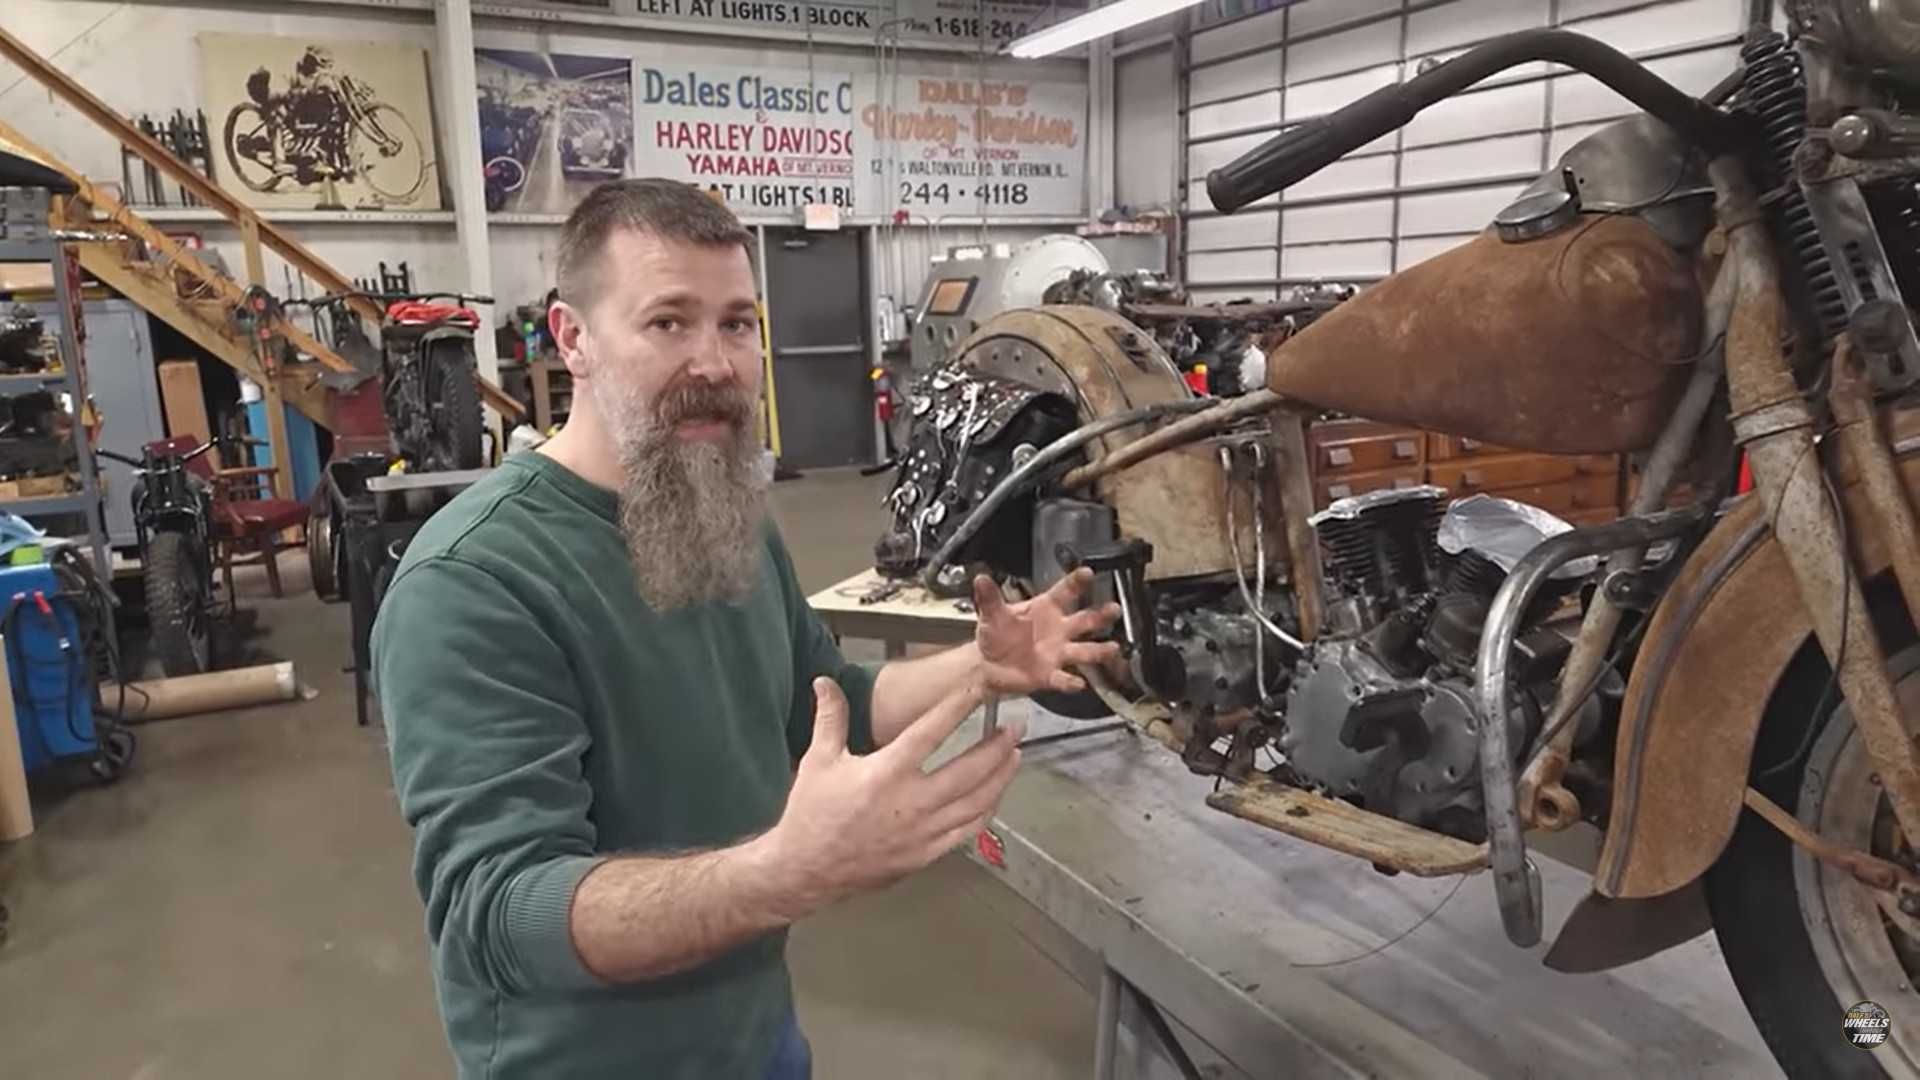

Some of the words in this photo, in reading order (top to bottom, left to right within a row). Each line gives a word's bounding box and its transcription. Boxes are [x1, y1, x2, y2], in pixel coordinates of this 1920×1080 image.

[636, 0, 680, 15] LEFT
[690, 0, 715, 17] AT
[807, 7, 870, 28] BLOCK
[642, 68, 731, 108] Dales
[737, 75, 829, 114] Classic
[656, 120, 754, 151] HARLEY
[686, 153, 781, 177] YAMAHA
[974, 148, 1020, 161] VERNON
[900, 182, 949, 205] 244
[974, 182, 1028, 205] 4118
